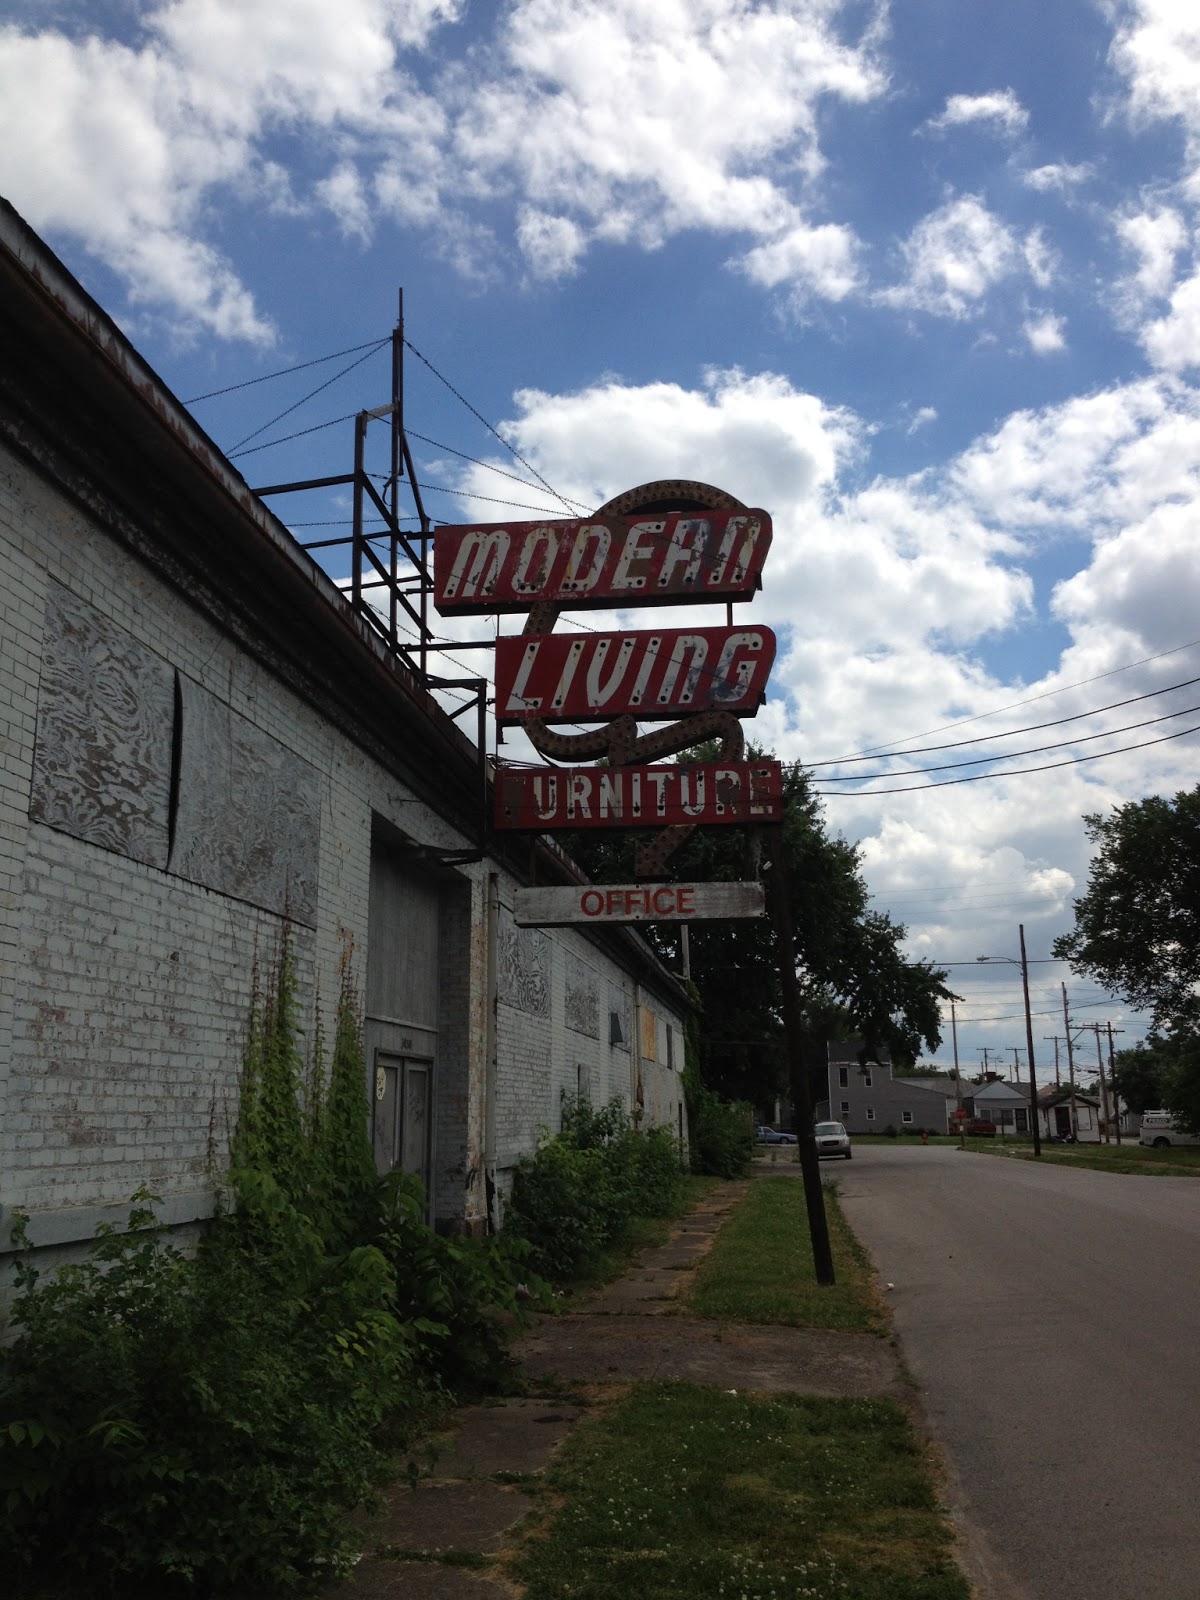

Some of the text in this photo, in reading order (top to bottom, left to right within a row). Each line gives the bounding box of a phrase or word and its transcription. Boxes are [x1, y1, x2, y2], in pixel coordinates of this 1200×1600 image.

[443, 516, 762, 598] MODERN
[505, 632, 764, 711] LIVING
[503, 770, 774, 820] URNITURE
[580, 888, 696, 917] OFFICE
